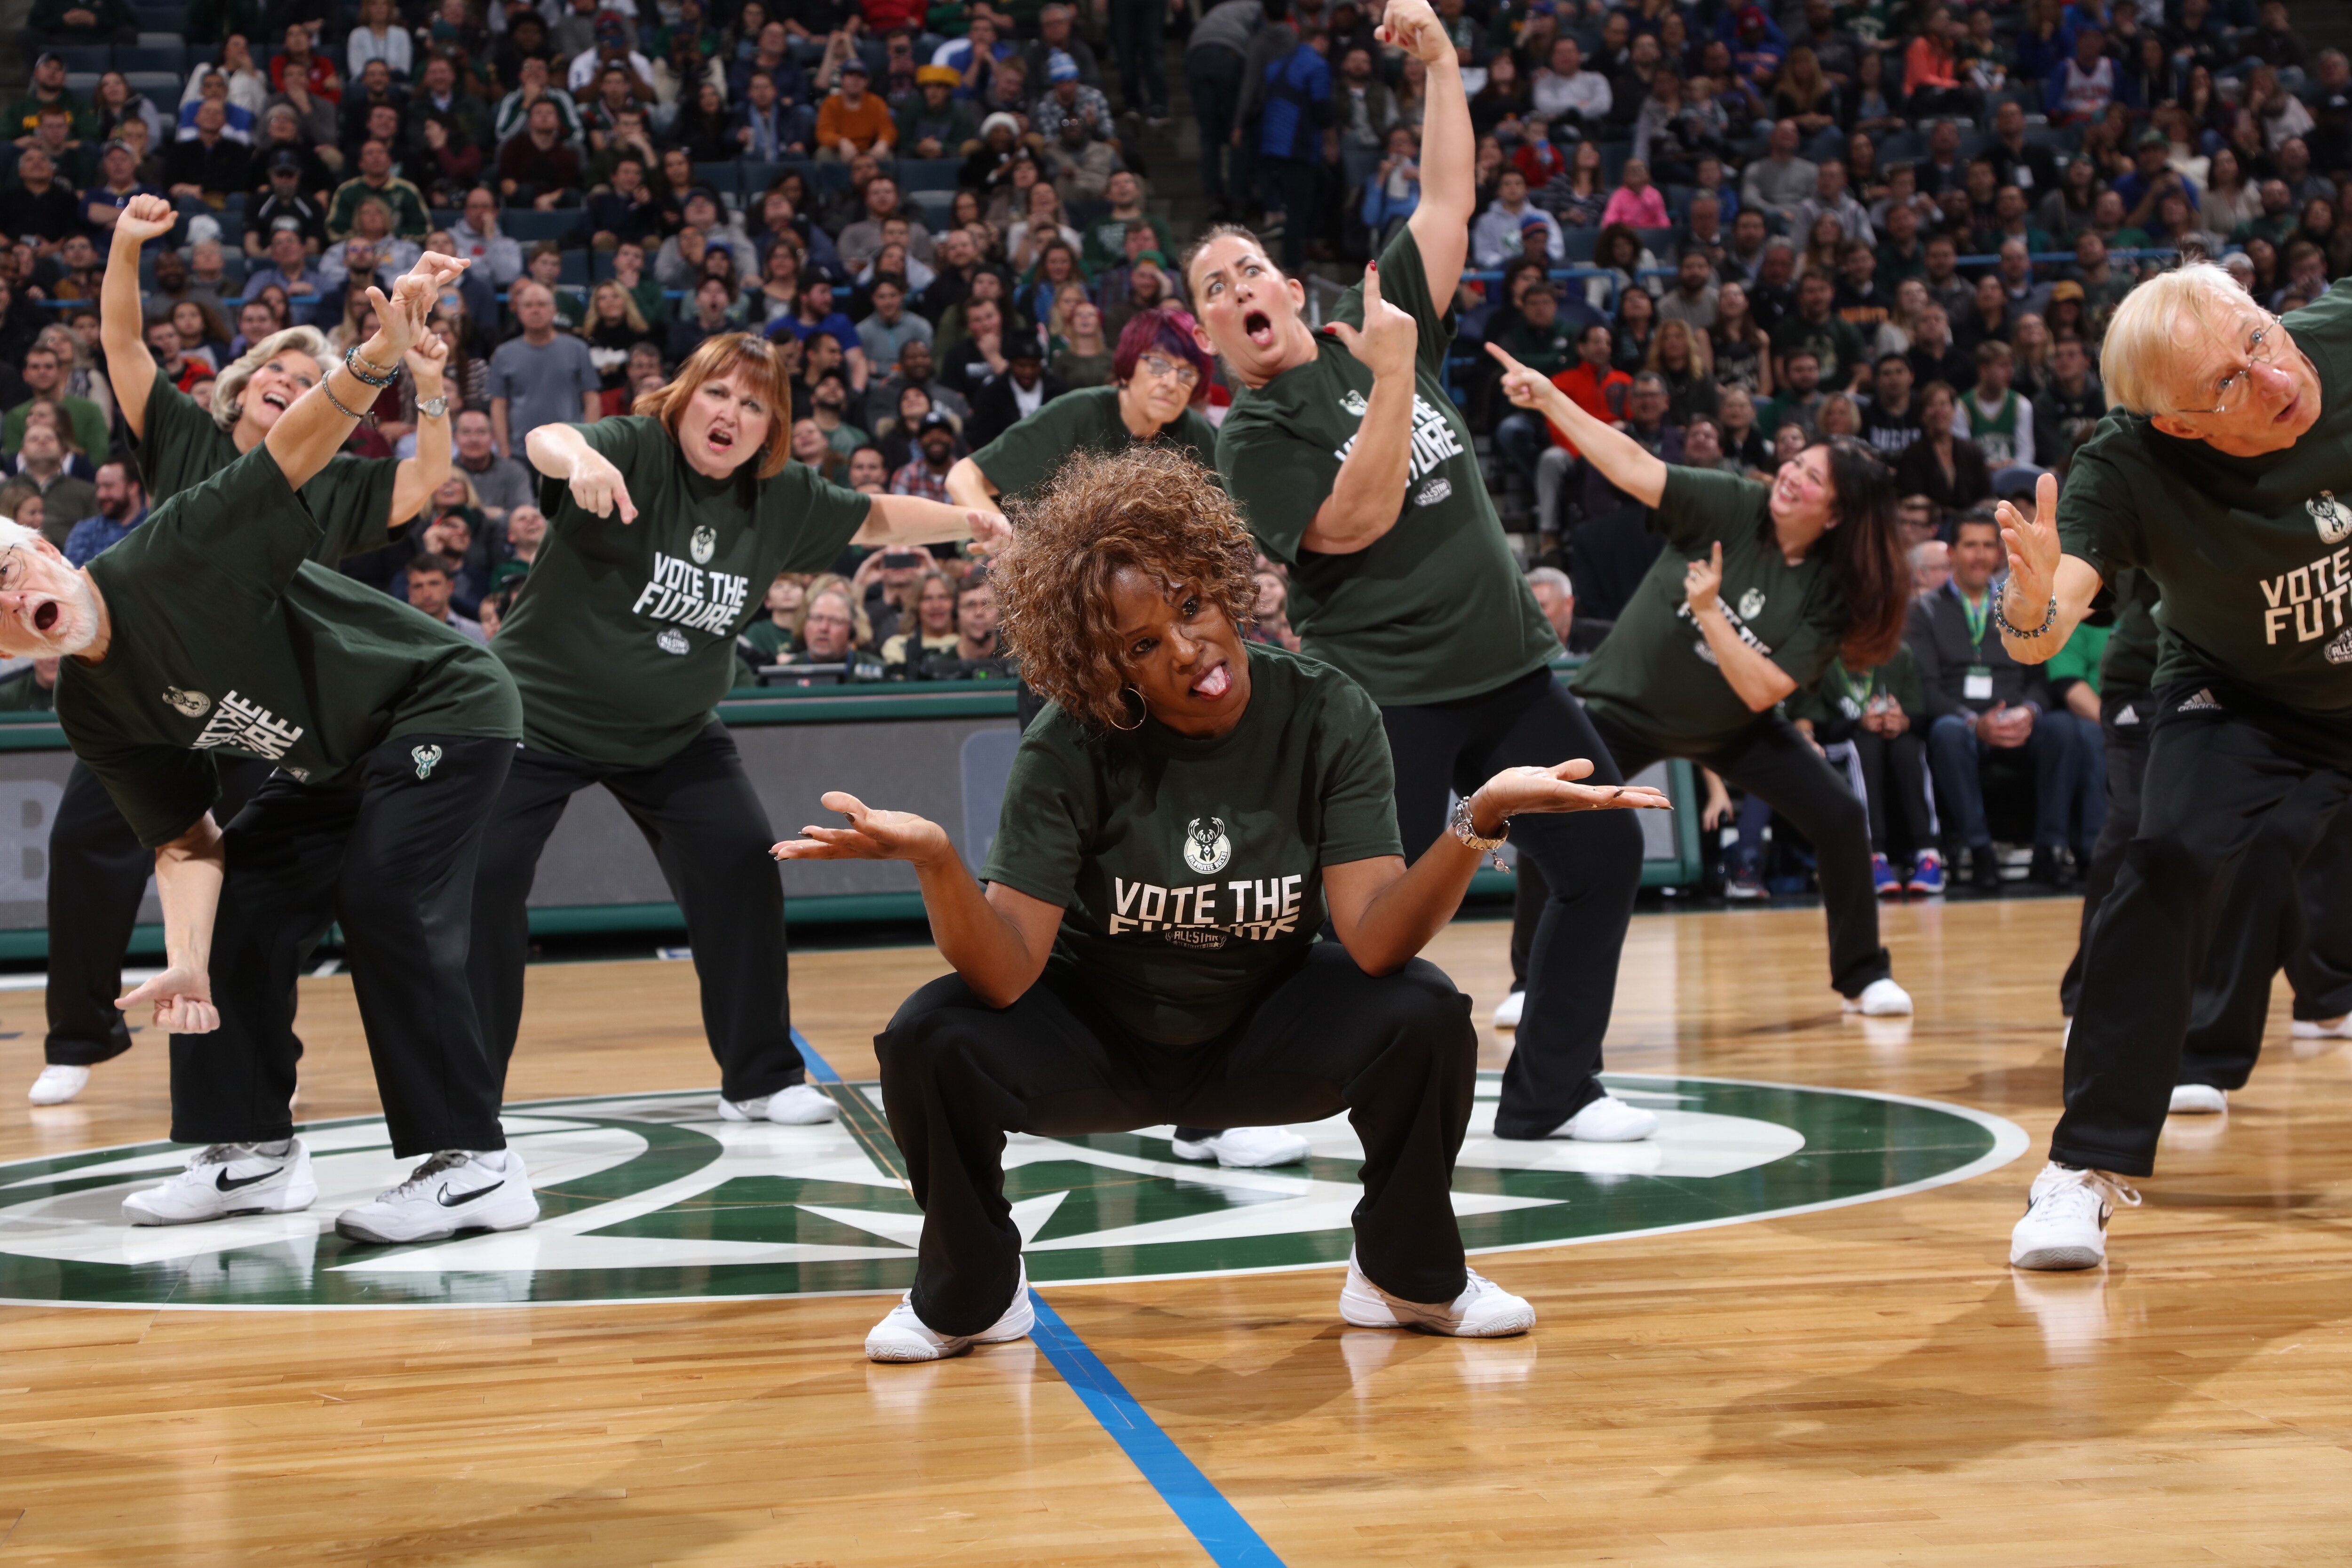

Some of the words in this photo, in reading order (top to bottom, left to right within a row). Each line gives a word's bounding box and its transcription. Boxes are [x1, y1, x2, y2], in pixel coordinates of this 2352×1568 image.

[653, 551, 704, 599] VOTE
[709, 571, 749, 607] THE
[2260, 546, 2351, 607] VOTE
[632, 581, 741, 636] FUTURE
[2177, 702, 2222, 712] adidas
[1188, 855, 1214, 871] MILWAUKEE
[1214, 852, 1228, 868] BUCKS
[1115, 877, 1216, 923] VOTE
[1229, 874, 1302, 922] THE
